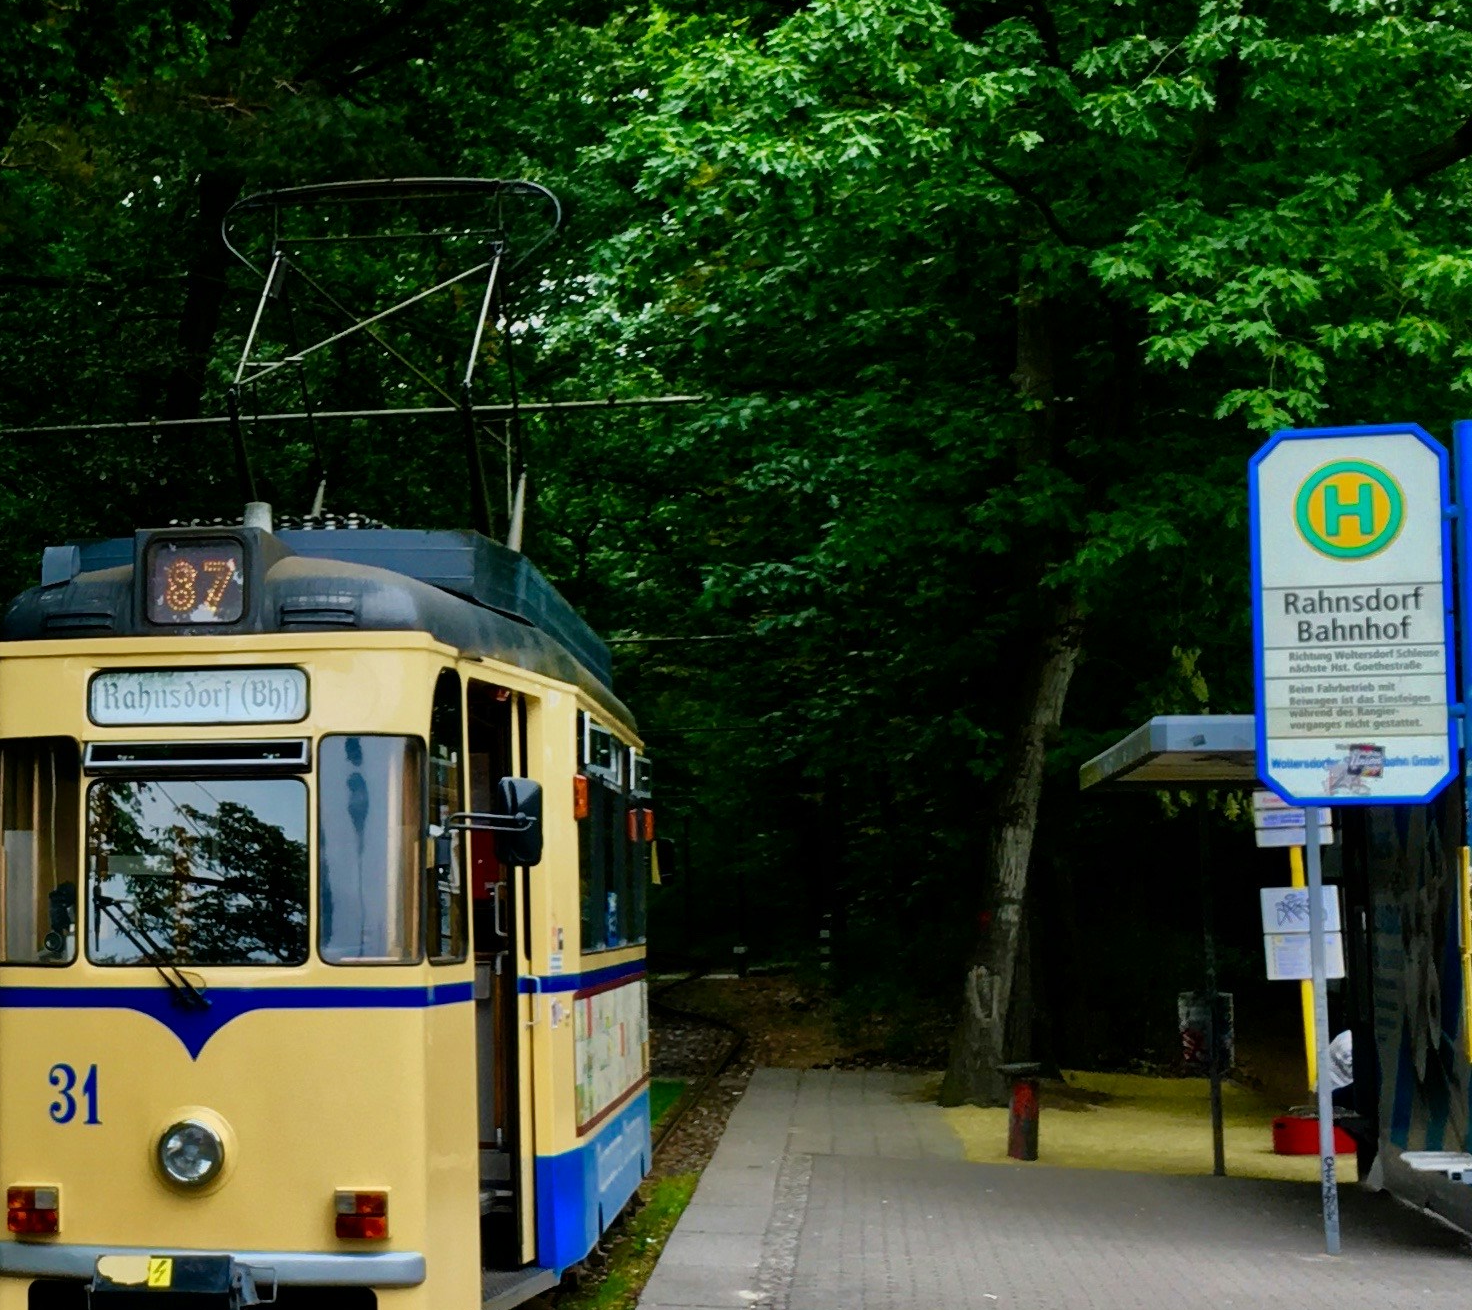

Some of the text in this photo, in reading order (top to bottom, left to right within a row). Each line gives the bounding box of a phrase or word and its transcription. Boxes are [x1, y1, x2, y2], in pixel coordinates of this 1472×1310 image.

[1325, 483, 1373, 536] H
[166, 557, 237, 612] 87
[1284, 587, 1423, 614] Rahnsdorf
[1297, 615, 1411, 642] Bahnhof
[1289, 649, 1440, 662] Richtung Woltersdorf Schleuse
[1289, 660, 1422, 673] nächste Hst. Goethestraße
[102, 674, 300, 716] Rahnsdorf (Bhf)
[1289, 682, 1395, 693] Beim Fahrbetrieb mit
[1289, 693, 1431, 708] Beiwagen ist das Einsteigen
[1290, 706, 1399, 718] während des Rangier-
[1290, 718, 1423, 732] vorganges nicht gestattet.
[49, 1063, 103, 1125] 31
